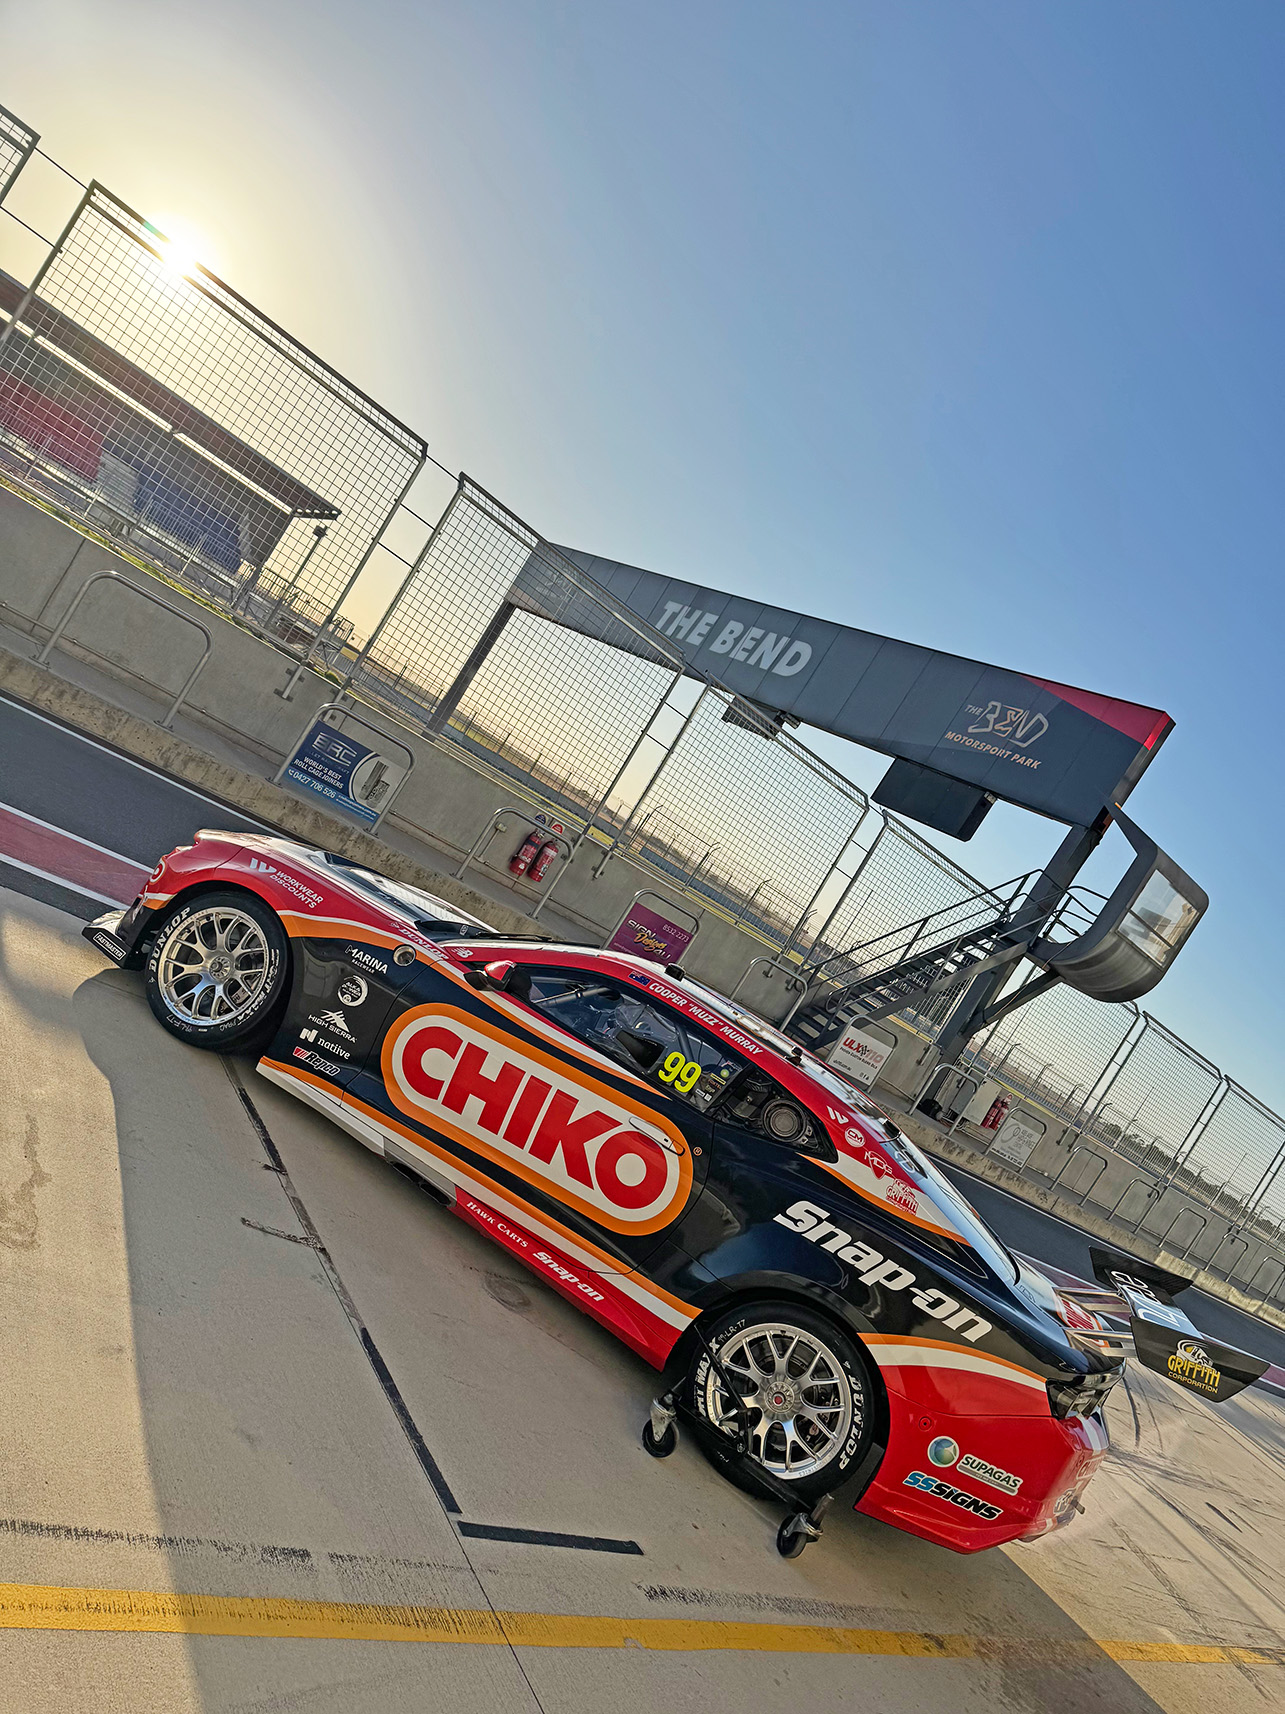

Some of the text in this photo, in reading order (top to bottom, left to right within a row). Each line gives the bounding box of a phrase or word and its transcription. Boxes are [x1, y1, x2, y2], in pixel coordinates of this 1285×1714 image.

[655, 600, 812, 677] THE BEND
[964, 704, 984, 716] THE
[967, 701, 1049, 748] BEND
[944, 731, 1042, 769] MOTORSPORT PARK
[293, 758, 308, 771] ROLL
[307, 766, 323, 779] CAGE
[321, 773, 343, 789] JOINERS
[303, 756, 328, 774] WORLD'S
[327, 767, 342, 780] BEST
[293, 771, 336, 799] 0427 706 526
[269, 874, 317, 909] DISCOUNTS
[276, 871, 324, 903] WORKWEAR
[151, 907, 191, 972] DUNLOP
[627, 919, 657, 938] SIGN
[662, 924, 677, 936] 8532
[95, 933, 125, 959] FASTMASTER
[344, 944, 388, 974] MARINA
[399, 929, 449, 960] DUNLOP
[351, 959, 375, 974] RACEWEAR
[308, 1014, 356, 1044] HIGH SIERRA
[648, 982, 688, 1008] COOPER
[720, 1026, 764, 1055] MURRAY
[318, 1037, 351, 1060] natiive
[842, 1037, 864, 1053] ULX
[304, 1051, 340, 1076] Repco
[658, 1051, 702, 1093] 99
[401, 1025, 669, 1210] CHIKO
[886, 1186, 919, 1213] GRIFFITH
[466, 1201, 529, 1248] HAWK CARTS
[532, 1251, 605, 1302] Snap-on
[772, 1200, 993, 1343] Snap-on
[1167, 1354, 1221, 1388] GRIFFITH
[1167, 1371, 1218, 1394] CORPORATION
[838, 1374, 864, 1470] DUNLOP
[961, 1455, 1021, 1488] SUPAGAS
